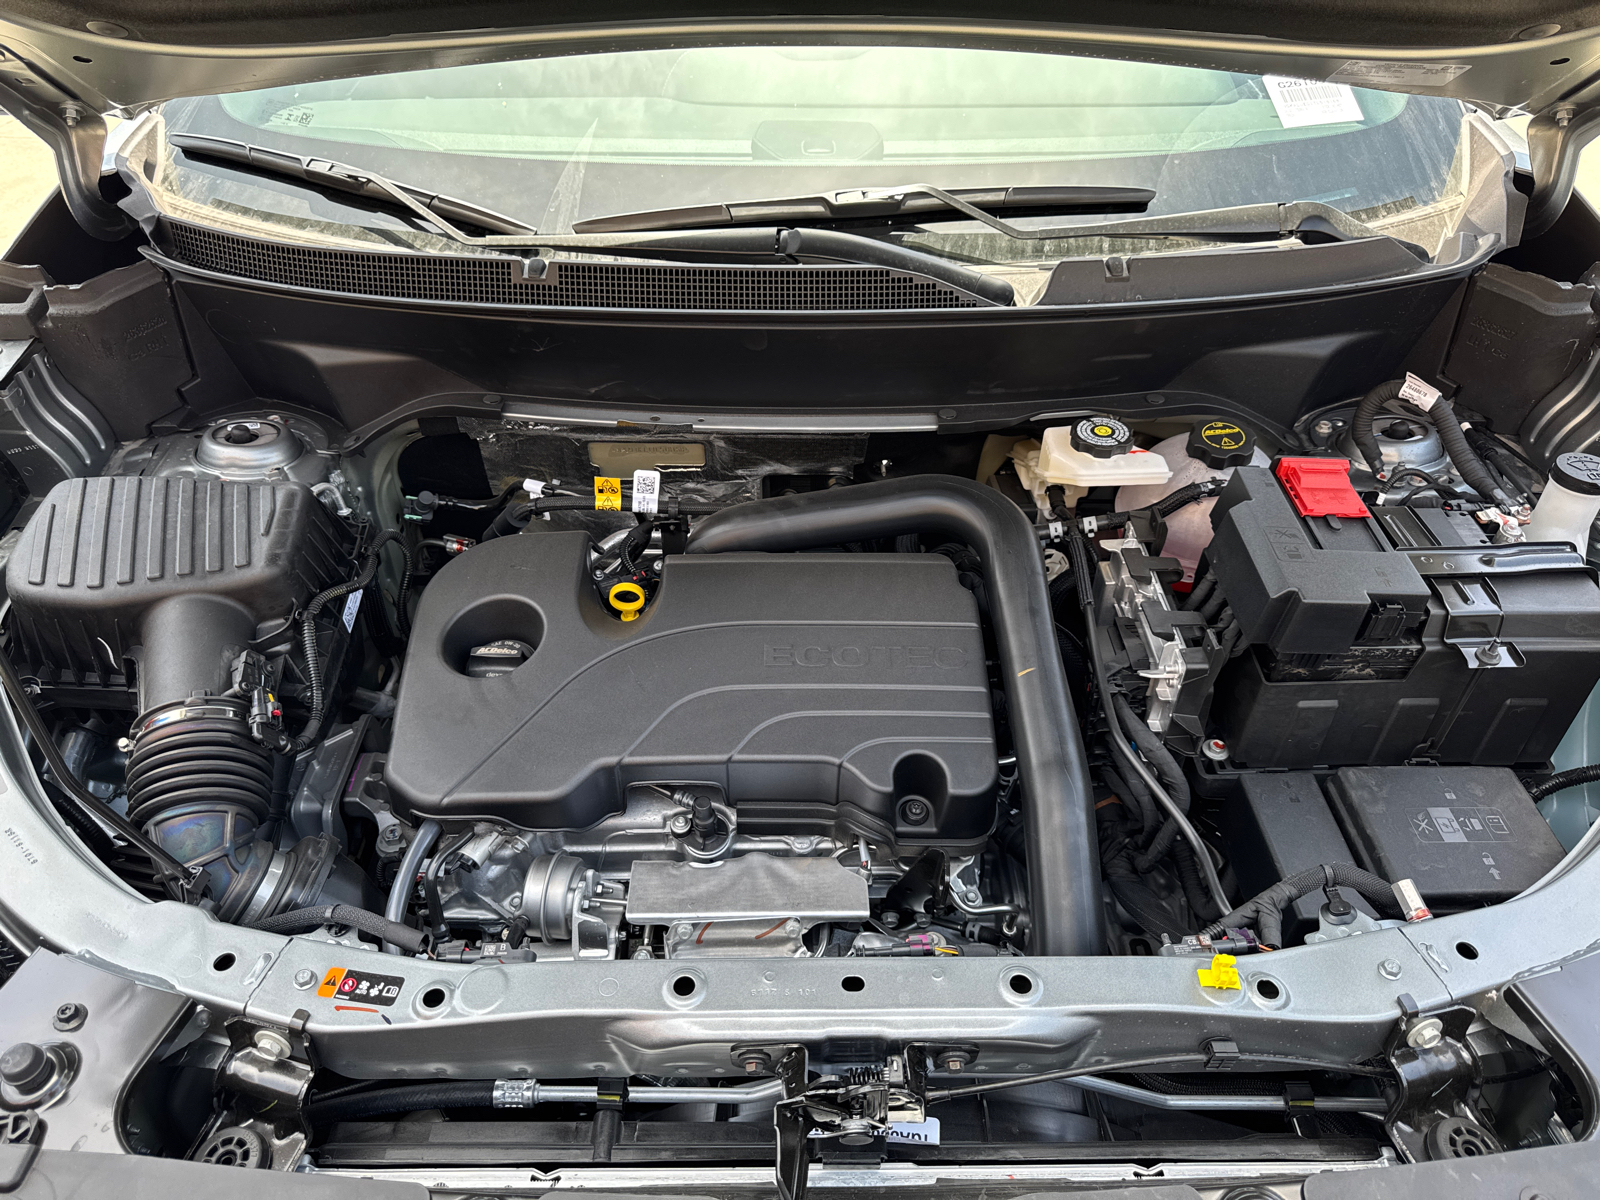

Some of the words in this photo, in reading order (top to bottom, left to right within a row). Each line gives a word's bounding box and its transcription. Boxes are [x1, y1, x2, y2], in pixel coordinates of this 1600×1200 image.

[1203, 428, 1240, 437] ACDelco
[476, 647, 518, 655] ACDelco
[764, 646, 968, 669] ECOTEC
[500, 943, 507, 951] B
